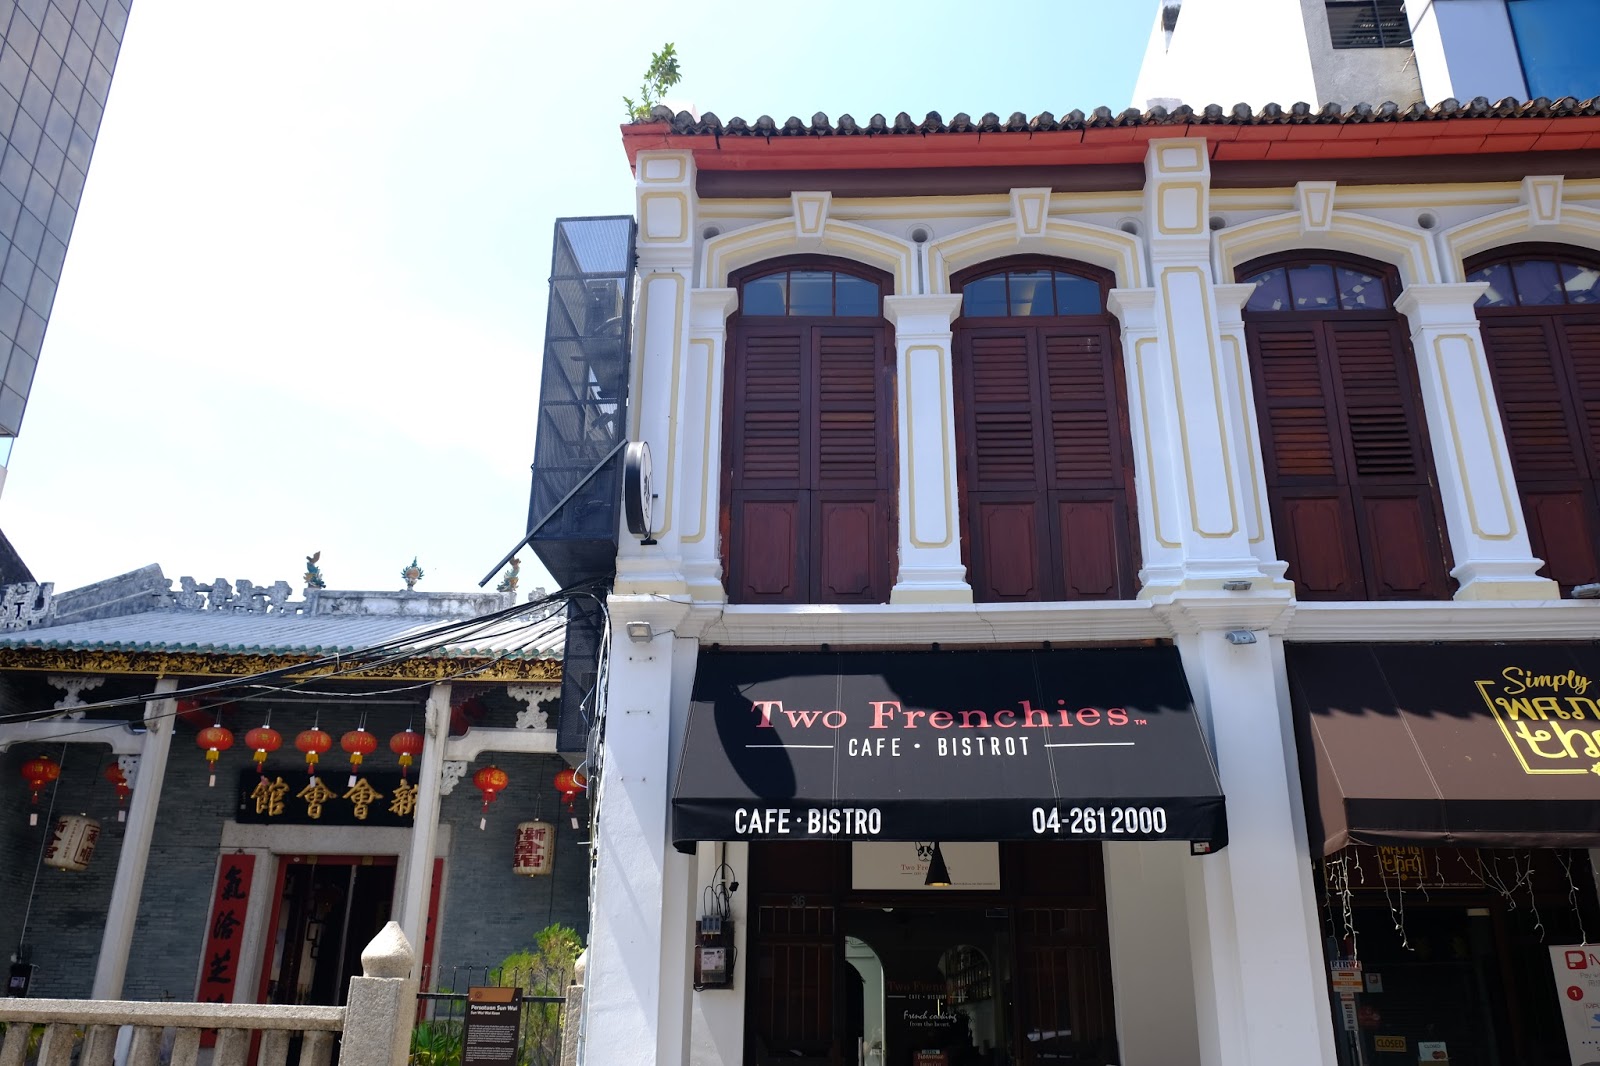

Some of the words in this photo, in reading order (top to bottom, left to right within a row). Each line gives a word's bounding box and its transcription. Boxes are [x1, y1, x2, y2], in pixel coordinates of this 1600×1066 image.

[1502, 666, 1592, 695] Simply
[751, 700, 847, 729] Two
[868, 699, 1130, 729] Frenchies
[848, 737, 901, 757] CAFE
[937, 736, 1029, 757] BISTROT
[735, 808, 791, 834] CAFE
[808, 808, 881, 834] BISTRO
[903, 1009, 928, 1020] French
[1376, 1039, 1405, 1048] CLOSED
